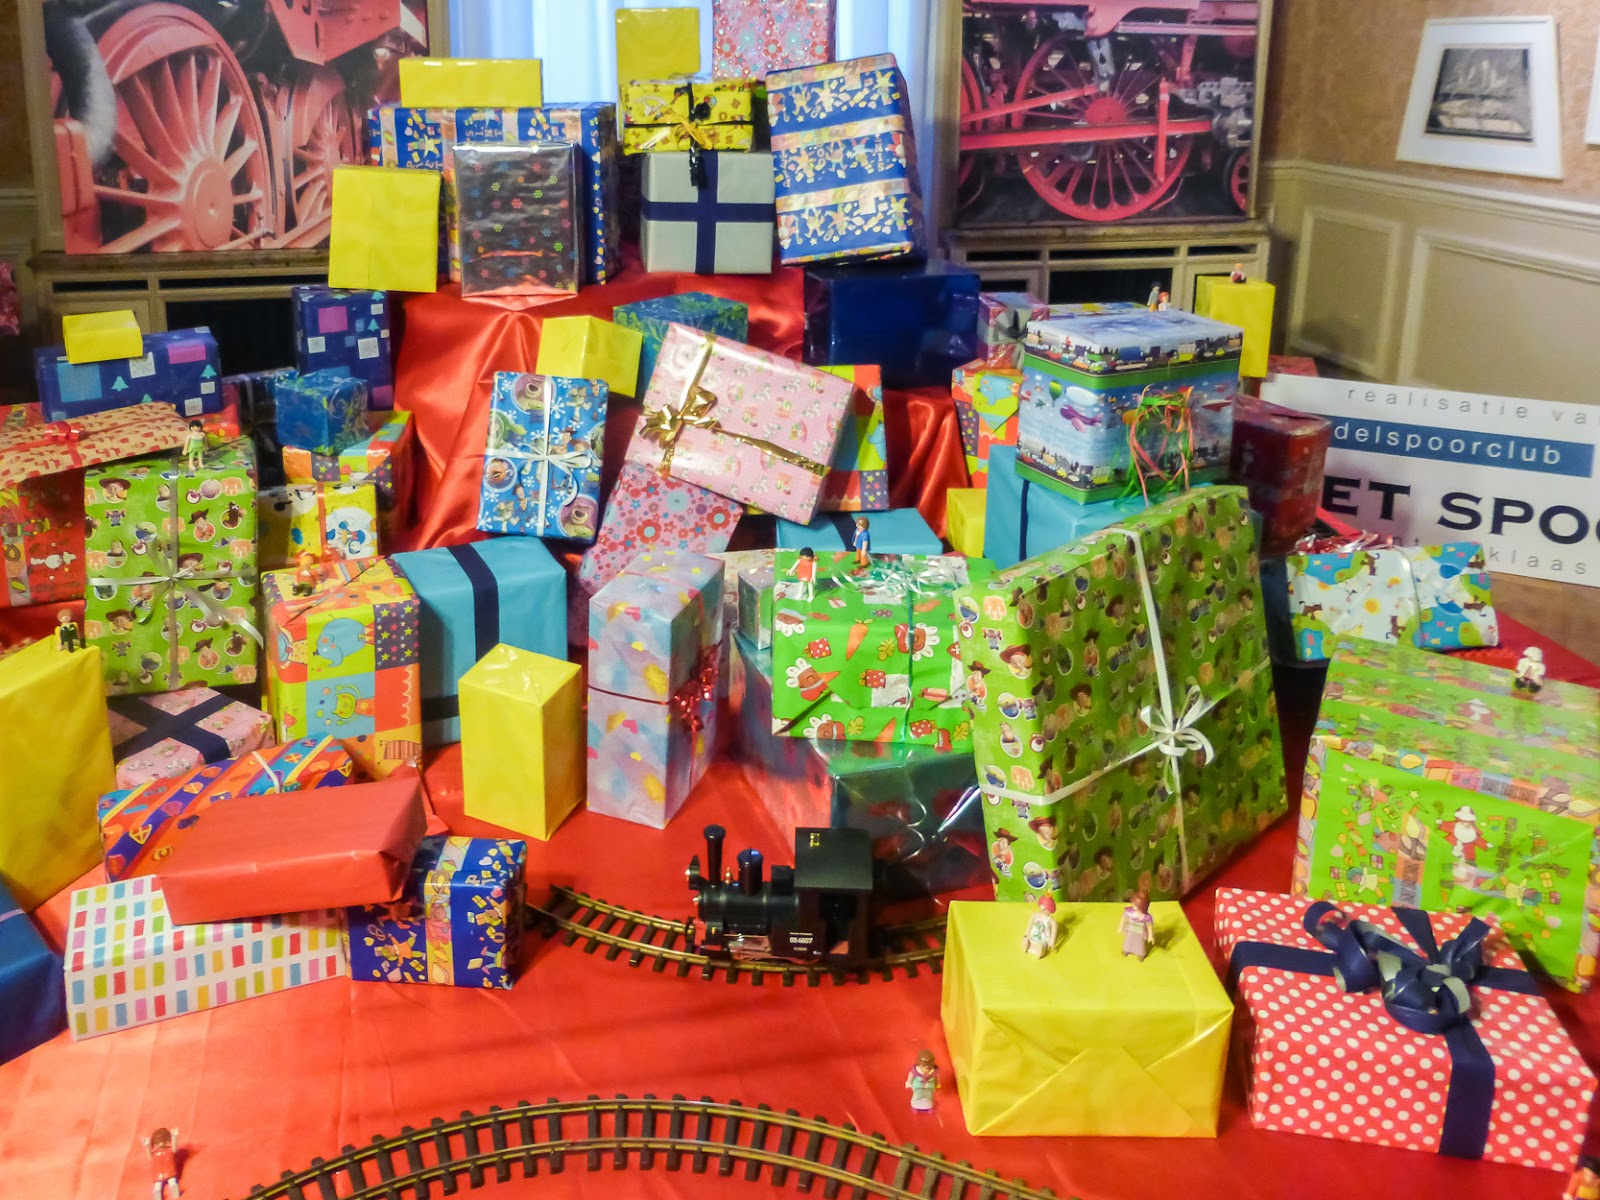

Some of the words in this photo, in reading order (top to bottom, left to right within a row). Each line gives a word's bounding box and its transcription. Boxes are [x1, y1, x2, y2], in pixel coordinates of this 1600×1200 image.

[1348, 387, 1529, 419] realisatie
[1552, 409, 1600, 425] va
[1436, 491, 1600, 545] SPO
